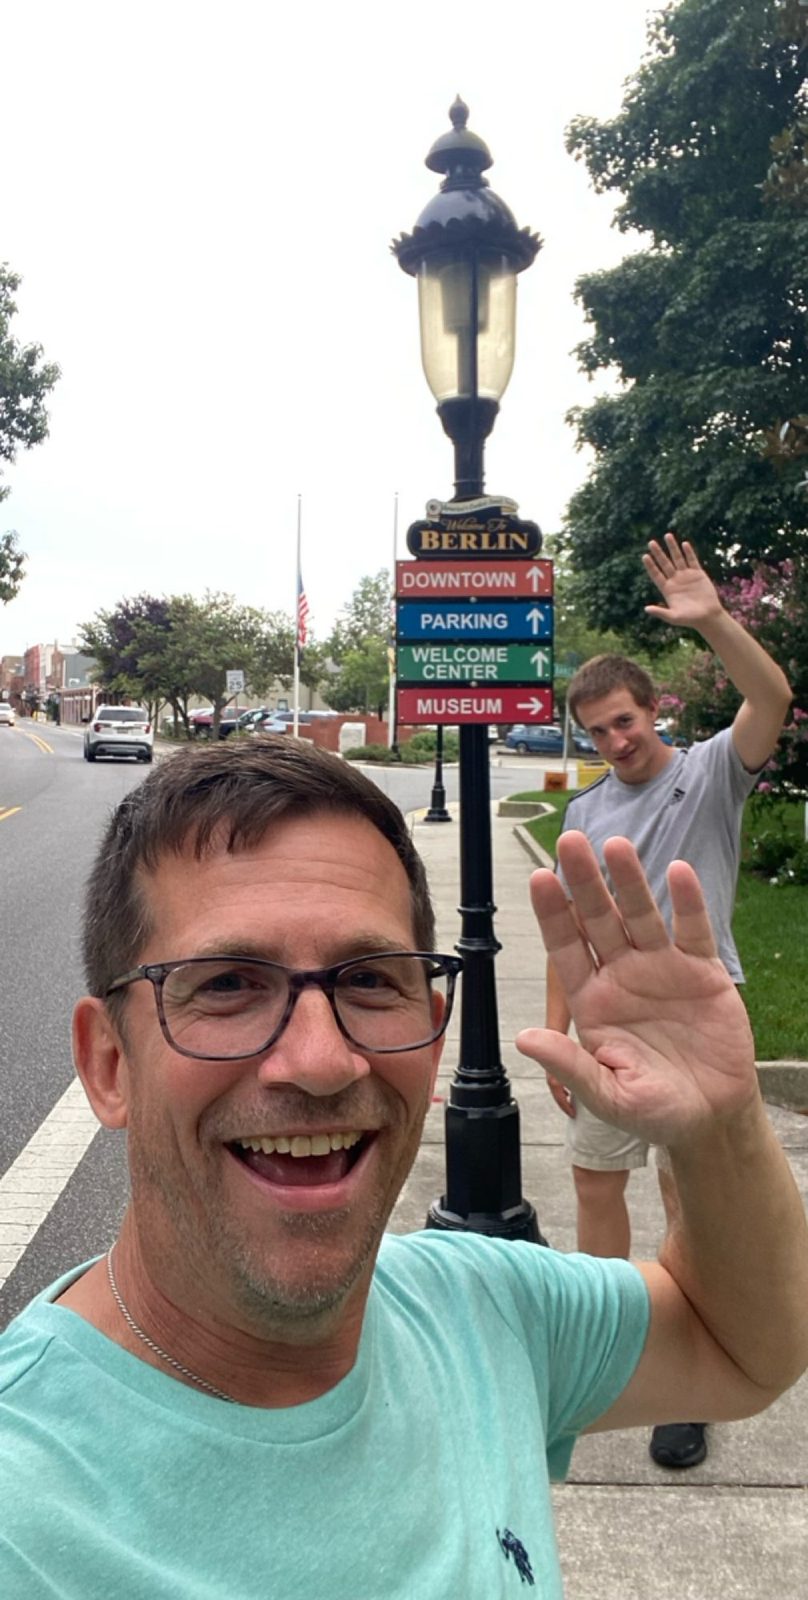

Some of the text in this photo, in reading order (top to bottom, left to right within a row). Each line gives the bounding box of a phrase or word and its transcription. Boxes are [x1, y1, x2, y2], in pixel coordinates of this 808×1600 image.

[420, 530, 528, 550] BERLIN
[402, 572, 516, 588] DOWNTOWN
[421, 613, 508, 629] PARKING
[412, 647, 508, 662] WELCOME
[422, 664, 498, 679] CENTER
[229, 681, 242, 690] 25
[417, 698, 502, 714] MUSEUM
